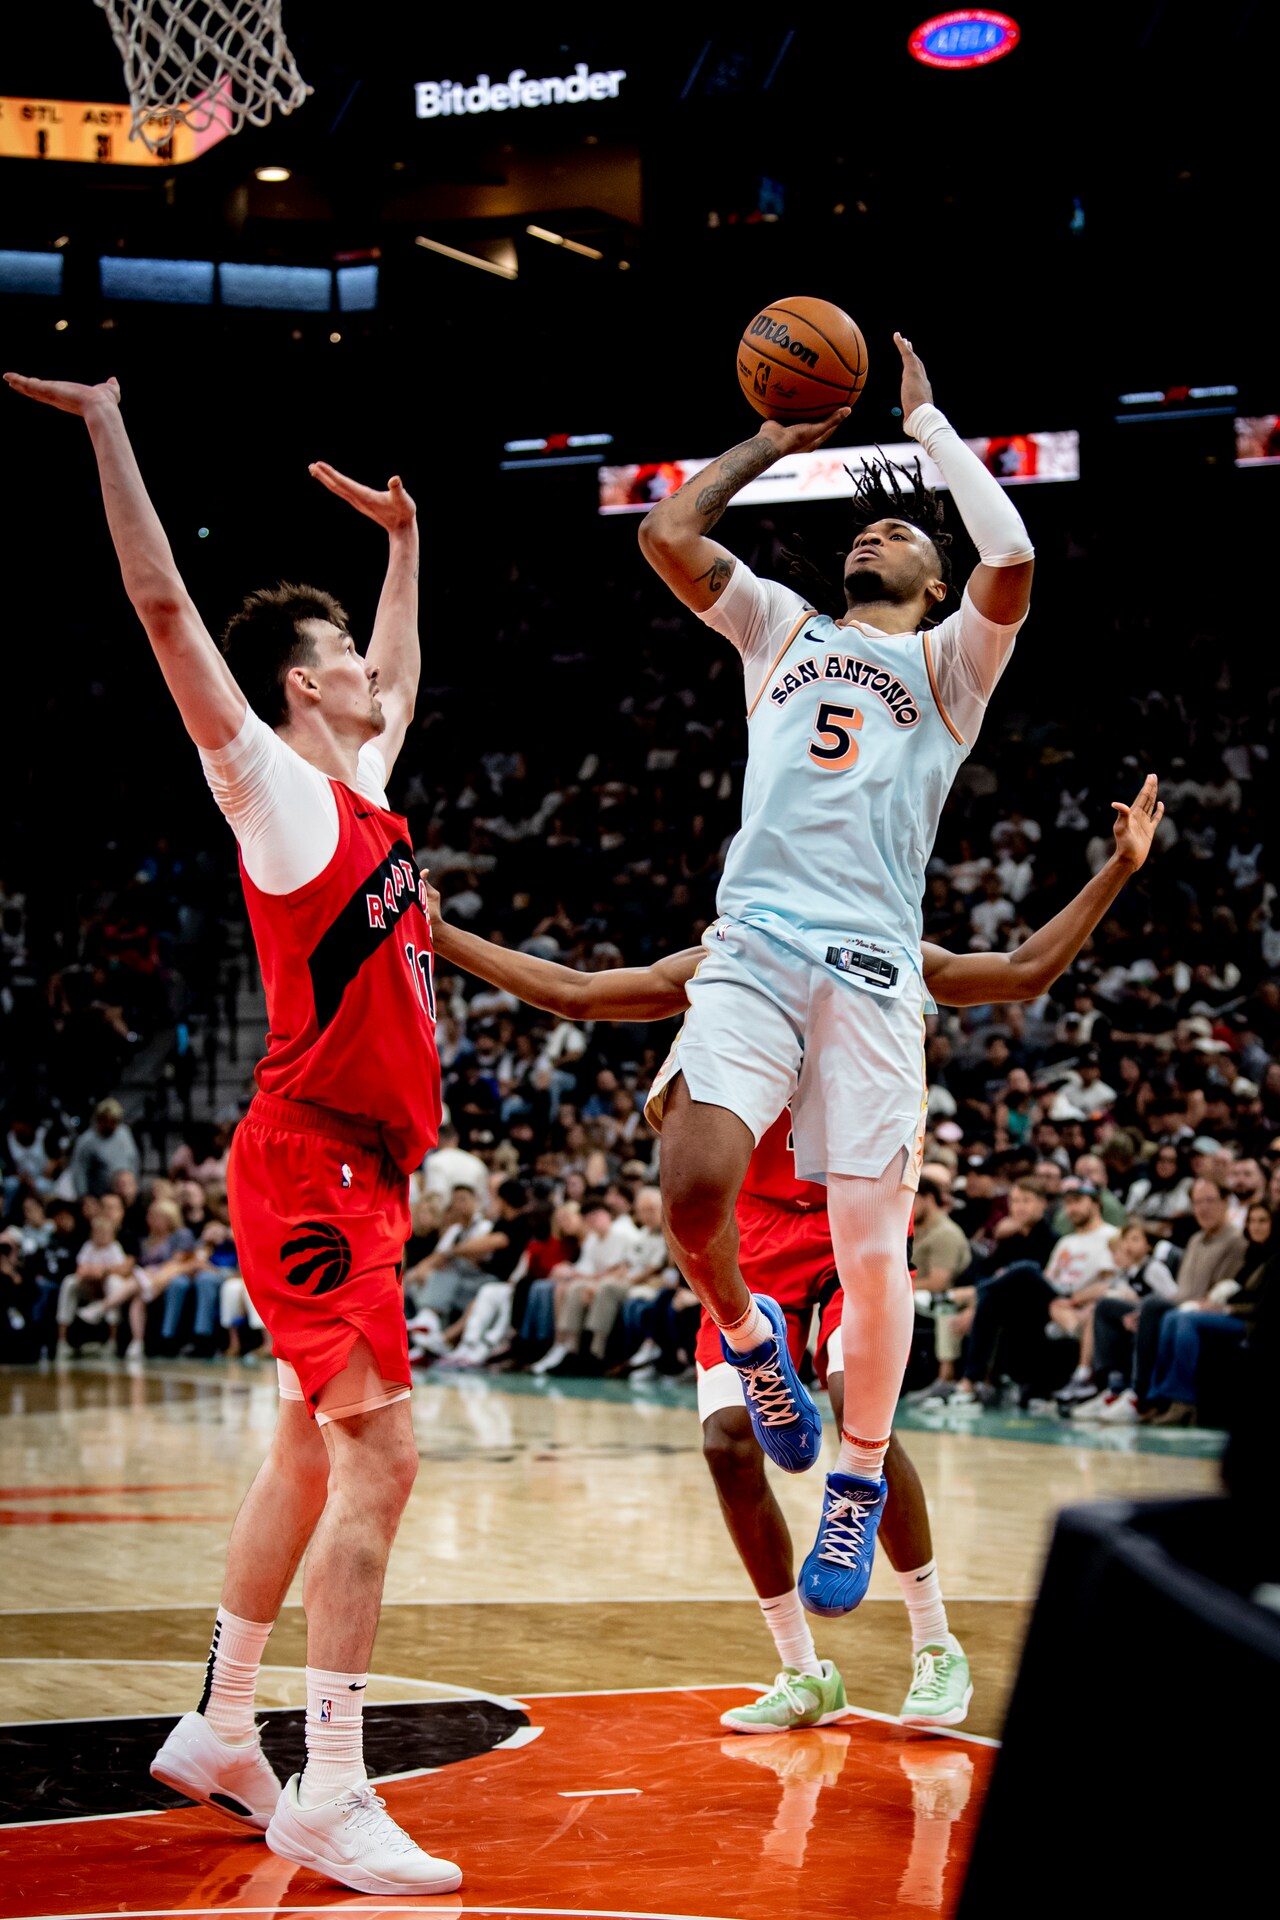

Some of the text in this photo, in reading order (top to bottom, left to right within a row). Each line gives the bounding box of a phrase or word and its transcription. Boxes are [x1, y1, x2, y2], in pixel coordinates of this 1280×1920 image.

[21, 105, 61, 122] STL
[83, 109, 123, 124] AST
[414, 62, 627, 119] Bitdefender
[749, 314, 820, 369] Wilson
[769, 654, 921, 728] SAN ANTONIO
[807, 702, 861, 769] 5
[366, 859, 433, 943] RAPTO
[405, 943, 437, 1024] 11
